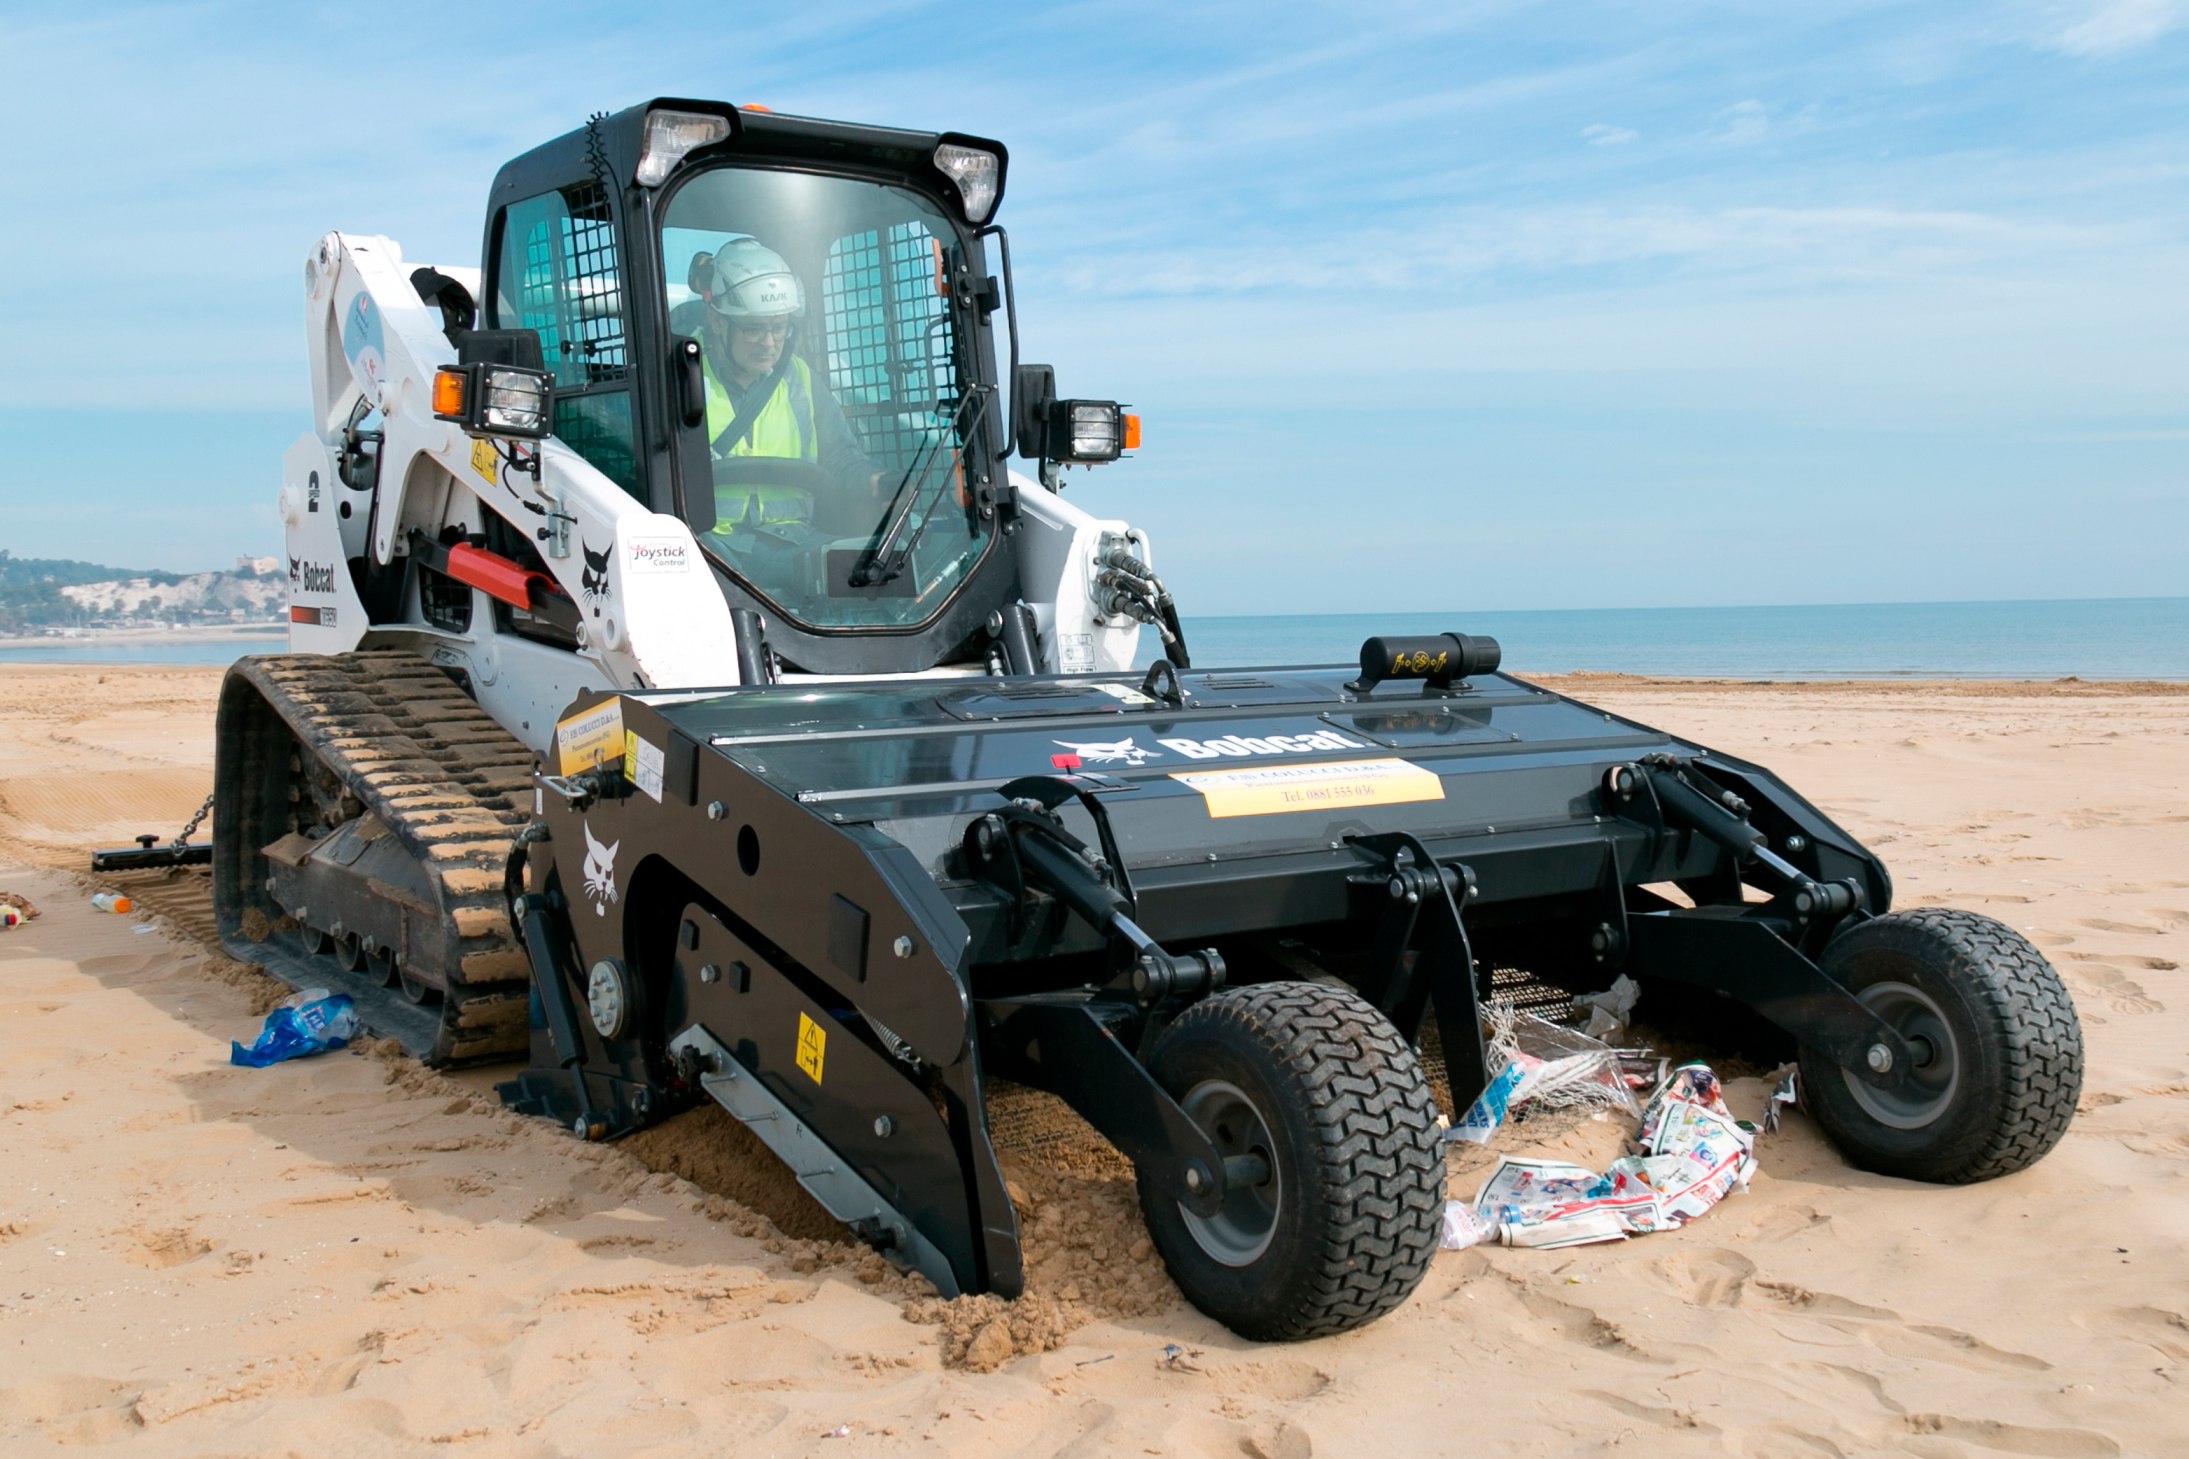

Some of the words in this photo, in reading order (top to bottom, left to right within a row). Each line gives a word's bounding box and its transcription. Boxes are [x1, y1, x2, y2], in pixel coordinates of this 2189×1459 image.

[653, 559, 685, 567] Control
[304, 561, 335, 593] Bobcat
[1156, 730, 1365, 759] Bobcat
[1281, 790, 1305, 802] Tel.
[1306, 788, 1331, 800] 0881
[1333, 786, 1353, 799] 555
[1355, 784, 1375, 797] 036
